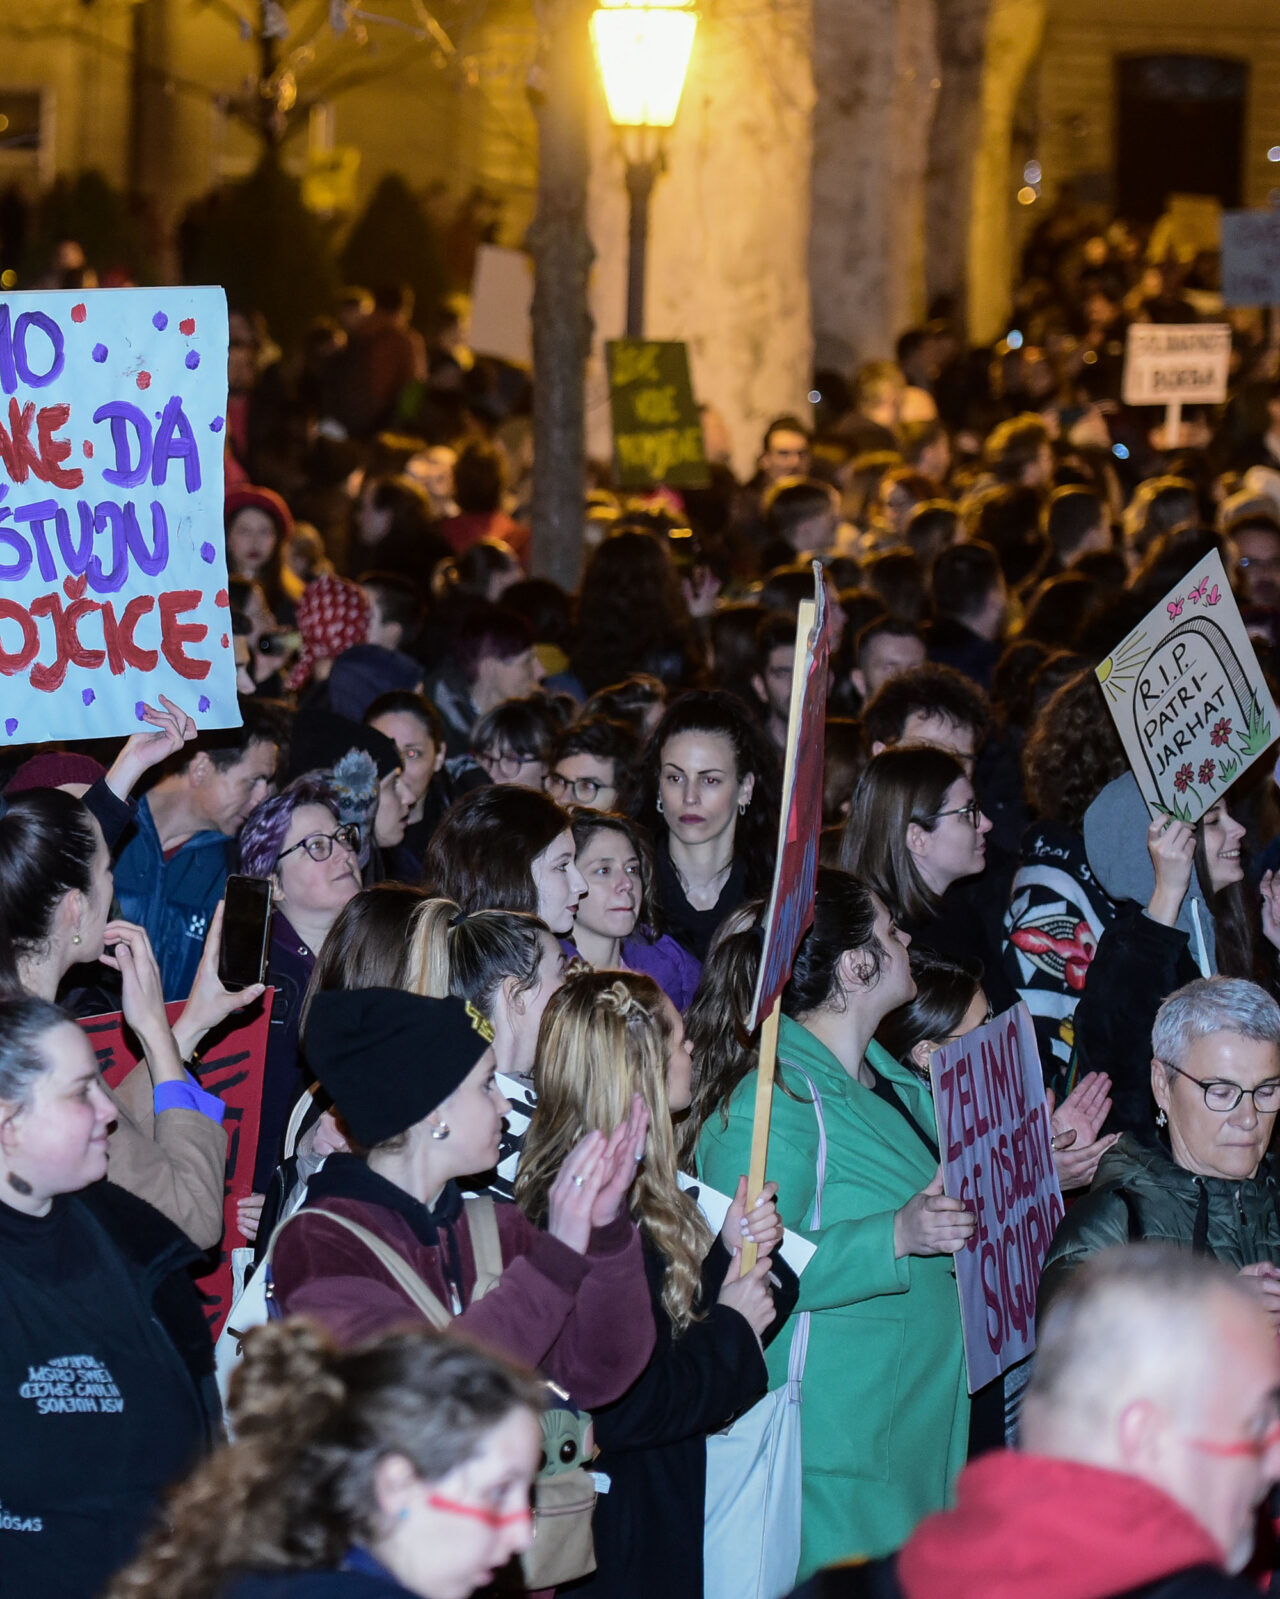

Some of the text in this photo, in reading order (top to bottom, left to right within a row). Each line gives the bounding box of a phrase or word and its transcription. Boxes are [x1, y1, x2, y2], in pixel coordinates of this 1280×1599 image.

[93, 395, 202, 494] DA
[1139, 643, 1191, 711] R.I.P.
[1143, 671, 1208, 748] PATRI-
[1154, 684, 1225, 777] JARHAT
[940, 1020, 1025, 1164] ŽELIMO
